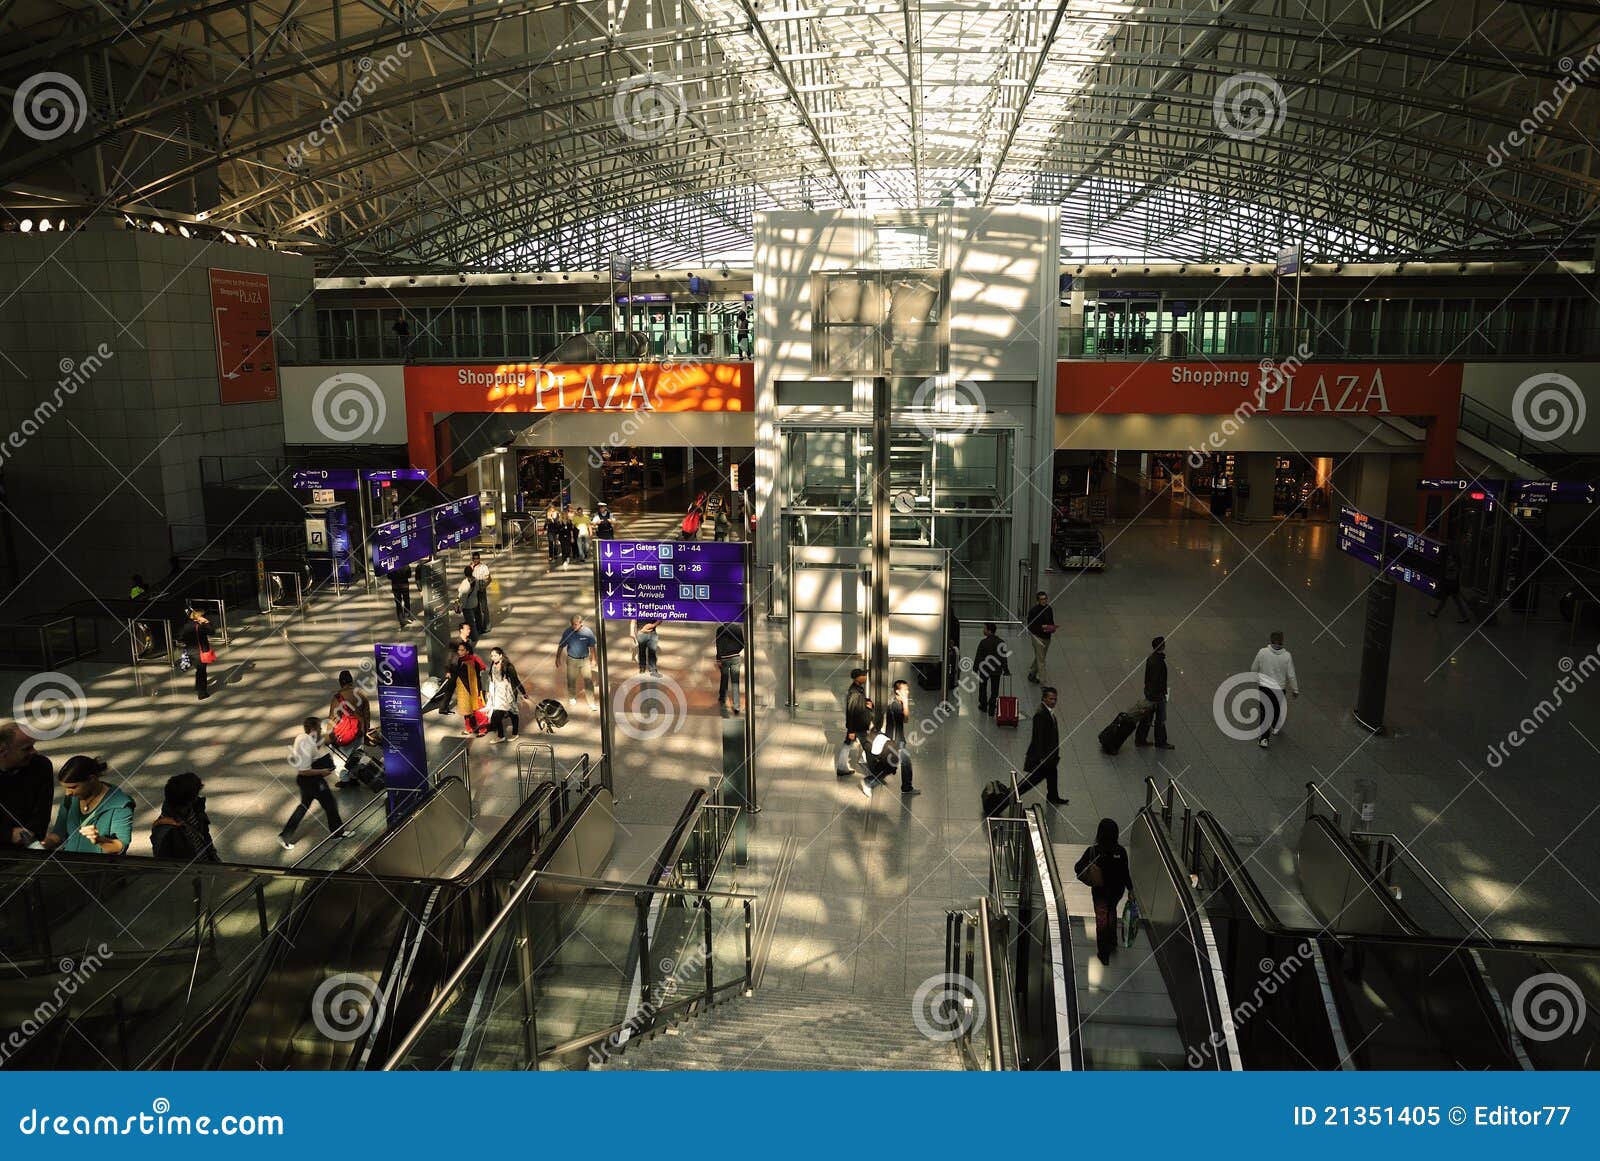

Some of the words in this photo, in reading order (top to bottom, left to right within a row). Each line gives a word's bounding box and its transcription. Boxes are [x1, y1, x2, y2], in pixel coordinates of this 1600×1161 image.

[239, 288, 263, 304] PLAZA
[458, 368, 526, 387] Shopping
[532, 367, 654, 411] PLAZA
[1171, 366, 1249, 387] Shopping
[1256, 367, 1391, 412] PLAZA
[321, 470, 328, 479] D
[391, 470, 398, 479] E
[1458, 479, 1467, 489] D
[1550, 481, 1559, 491] E
[635, 543, 657, 551] Gates
[636, 563, 657, 571] Gates
[637, 583, 667, 591] Ankunft
[637, 591, 665, 599] Arrivals
[637, 602, 675, 611] Treffpunkt
[638, 610, 668, 619] Meeting
[668, 611, 688, 619] Point
[382, 670, 393, 686] 3
